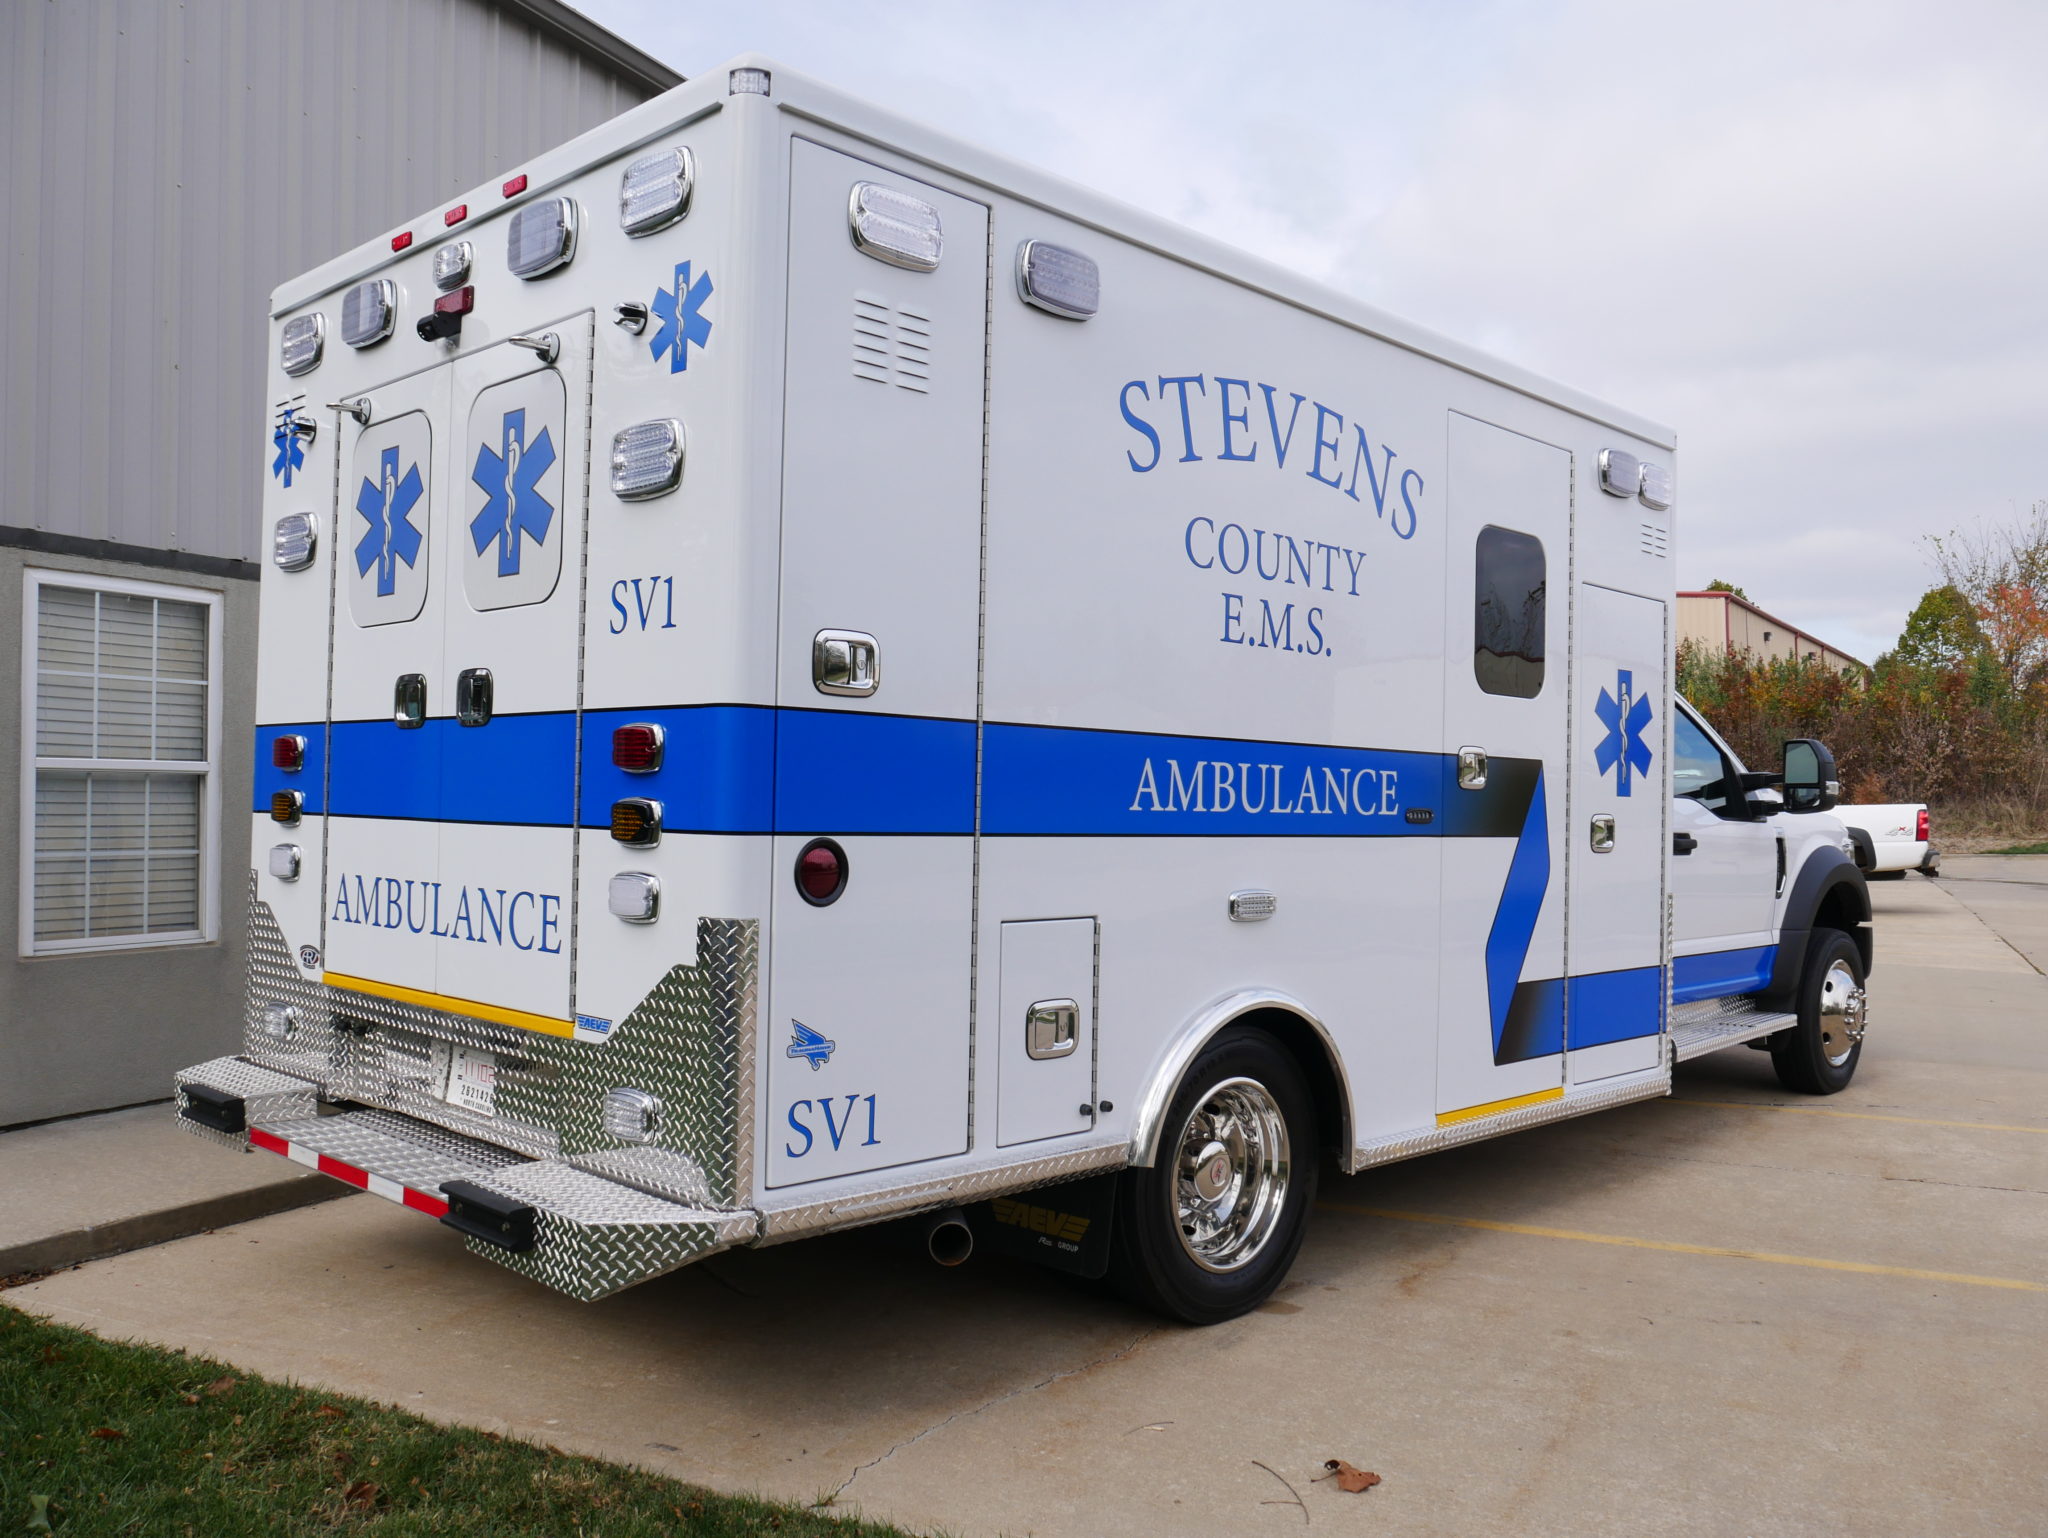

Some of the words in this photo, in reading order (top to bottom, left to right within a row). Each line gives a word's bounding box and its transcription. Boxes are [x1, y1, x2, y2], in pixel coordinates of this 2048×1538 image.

[1119, 373, 1424, 541] STEVENS
[1185, 516, 1366, 595] COUNTY
[610, 576, 676, 635] SV1
[1220, 593, 1332, 656] E.M.S.
[1129, 758, 1399, 816] AMBULANCE
[332, 873, 561, 954] AMBULANCE
[786, 1094, 881, 1158] SV1
